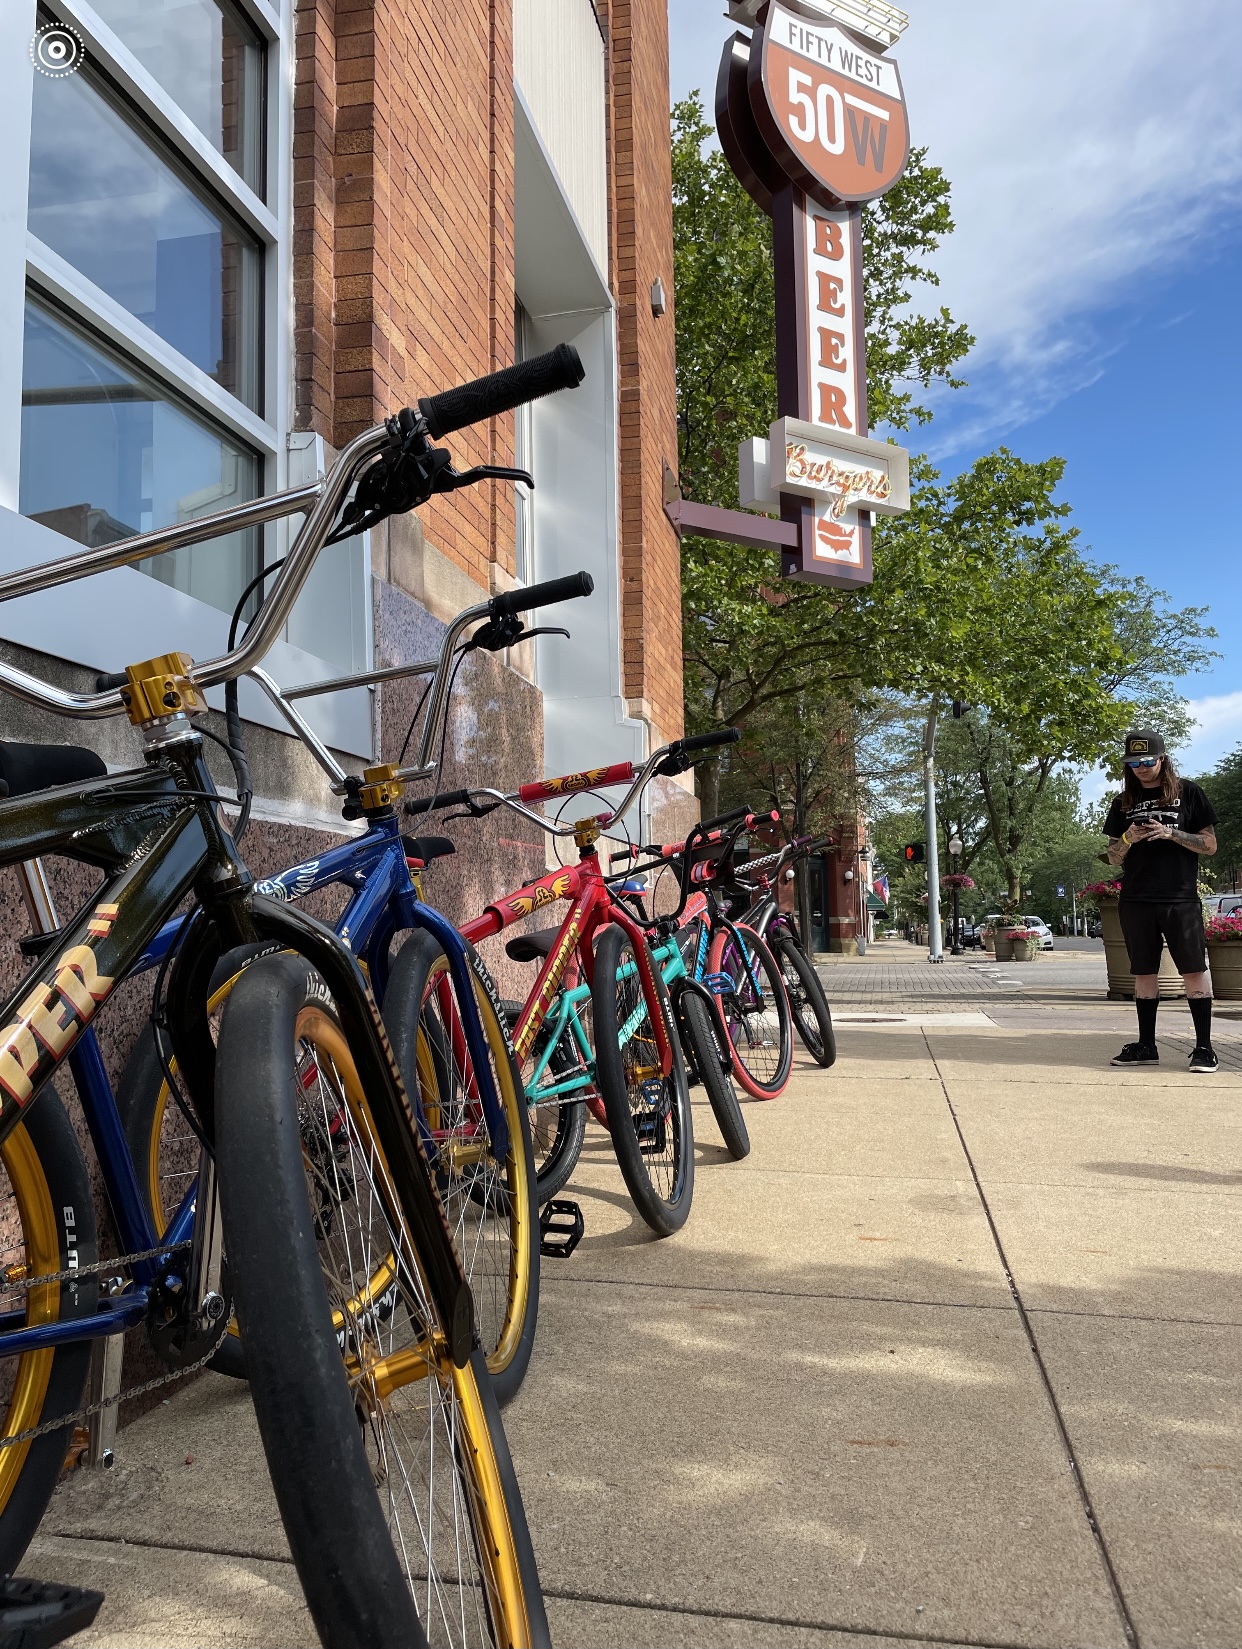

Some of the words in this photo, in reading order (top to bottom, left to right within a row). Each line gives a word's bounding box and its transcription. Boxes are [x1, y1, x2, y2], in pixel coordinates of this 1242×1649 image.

[788, 22, 834, 63] FIFTY
[839, 46, 882, 86] WEST
[812, 214, 853, 430] BEER
[785, 442, 893, 519] Burgers
[0, 945, 115, 1108] PER
[514, 999, 544, 1061] FAST
[542, 921, 582, 1004] RIPPER
